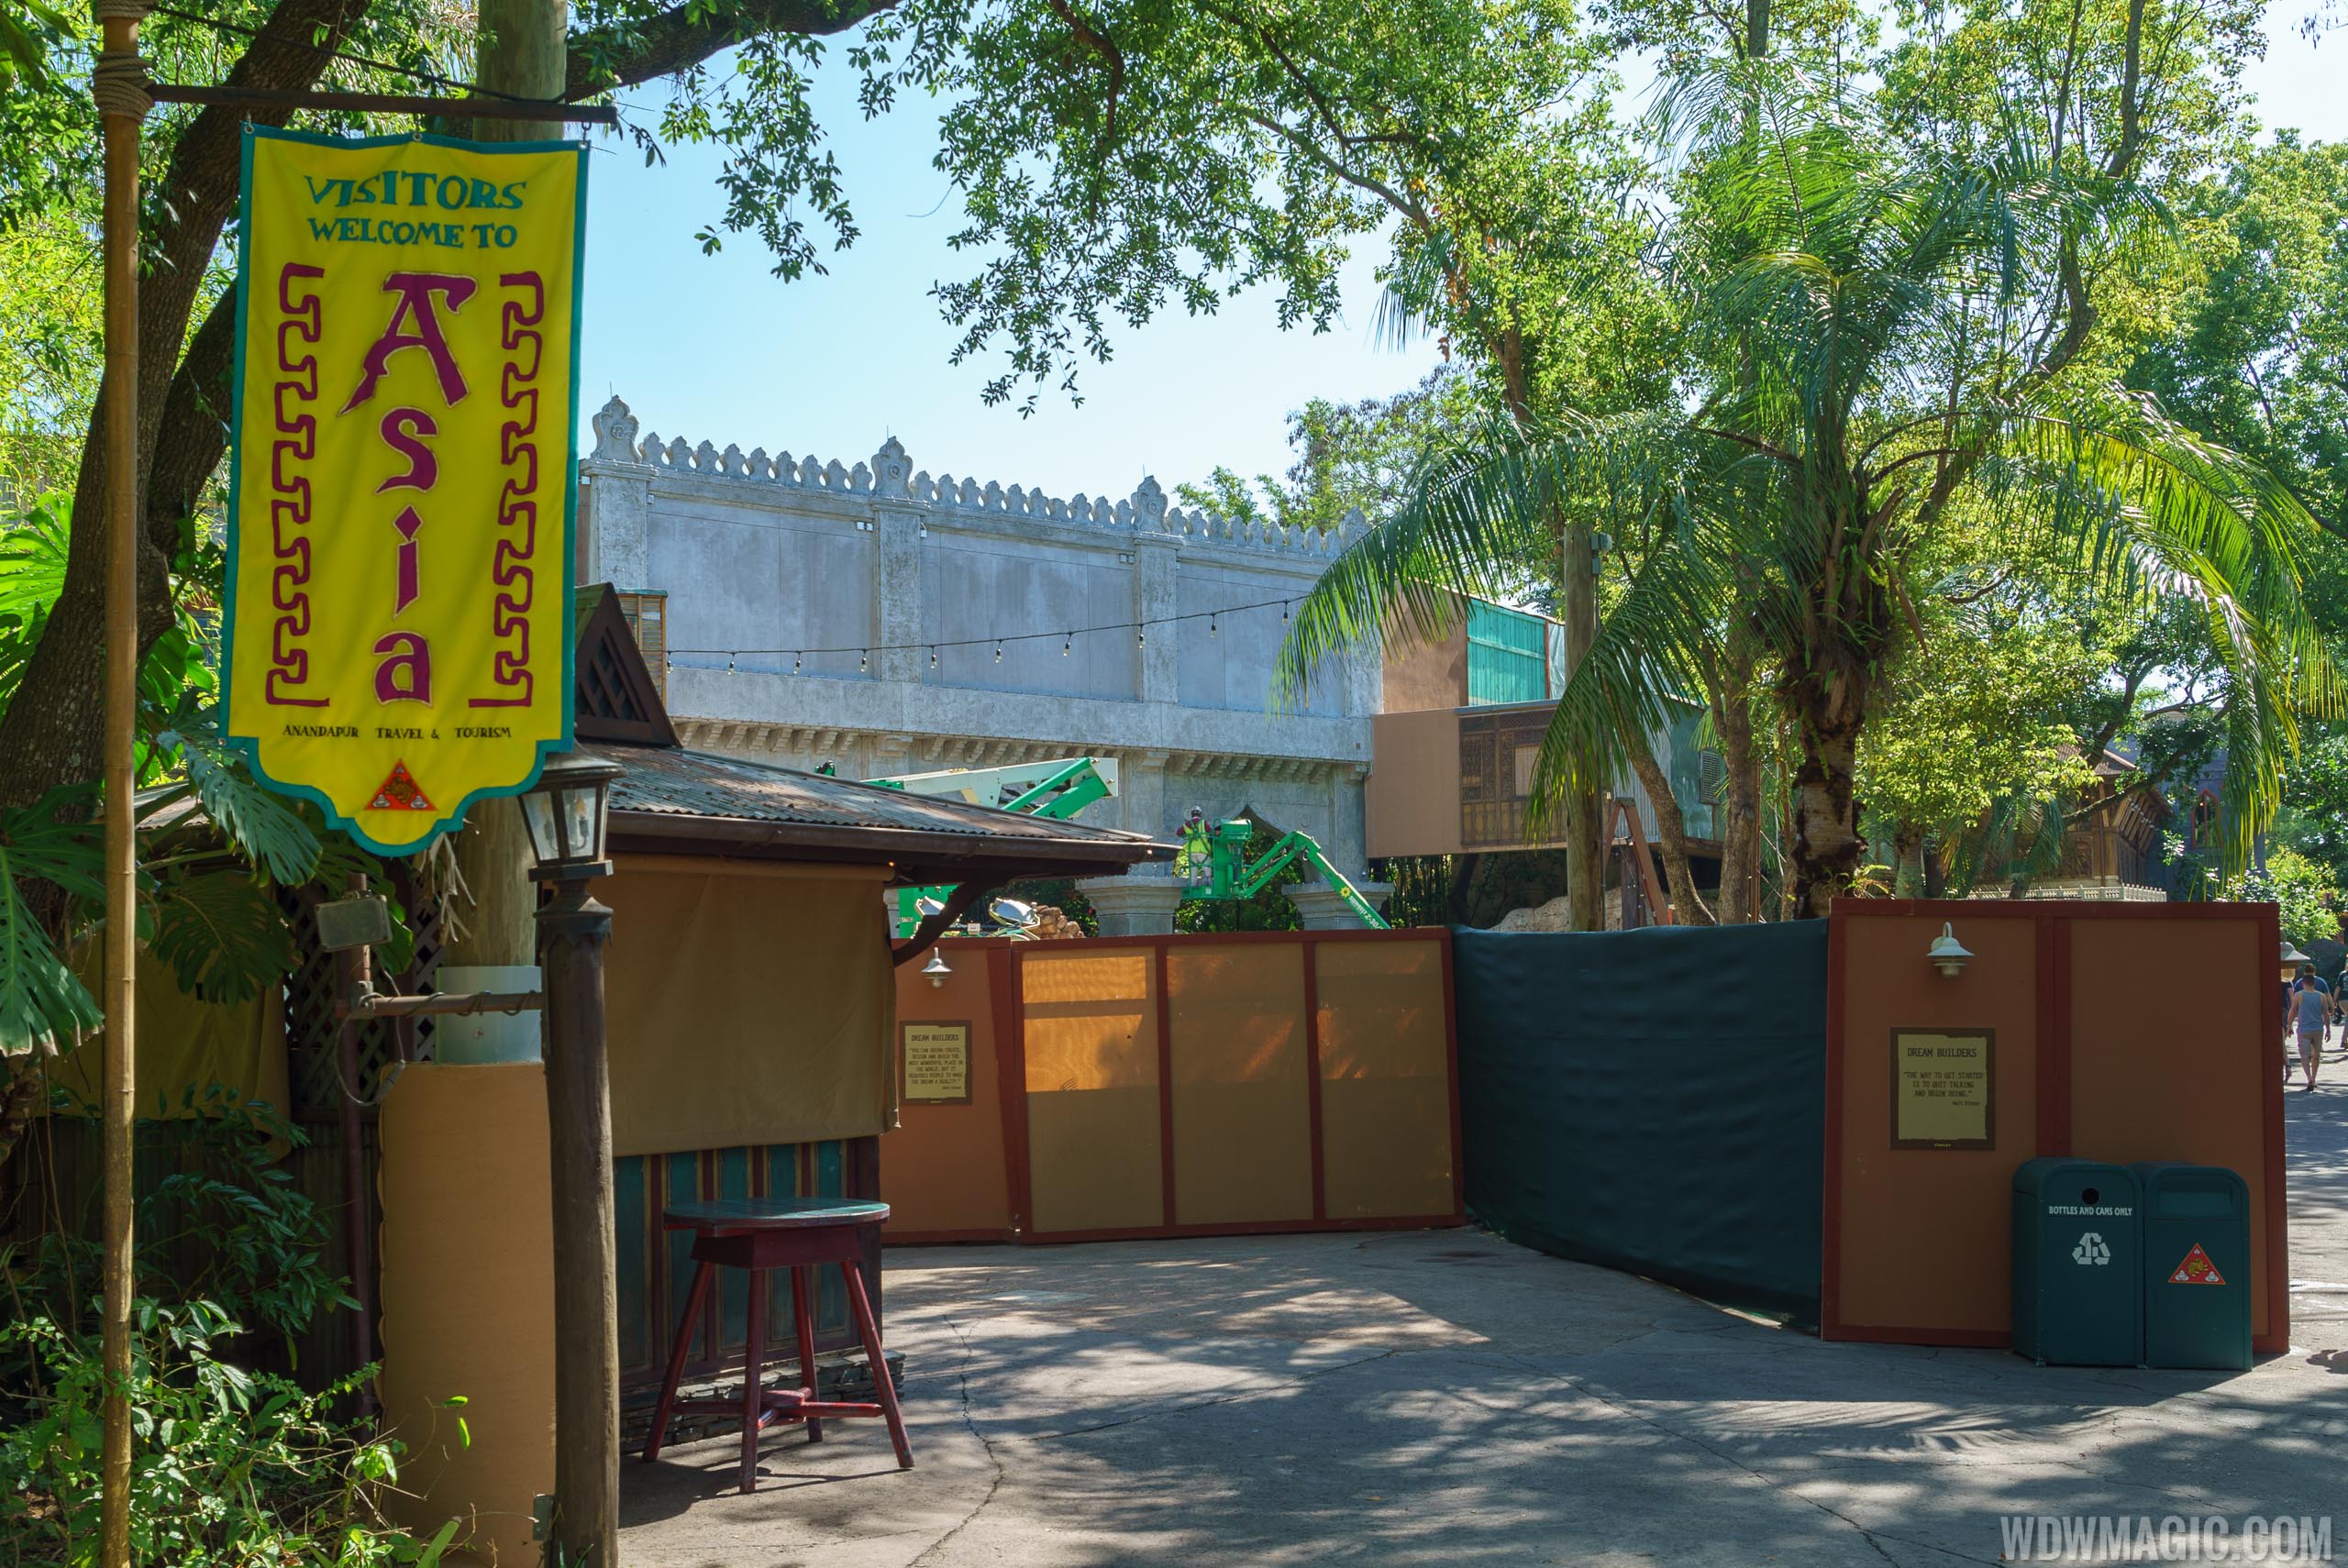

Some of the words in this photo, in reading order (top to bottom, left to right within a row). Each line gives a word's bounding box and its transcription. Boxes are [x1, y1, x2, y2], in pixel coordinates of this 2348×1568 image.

[304, 170, 527, 210] VISITORS
[307, 217, 464, 248] WELCOME
[471, 223, 518, 248] TO
[338, 271, 478, 707] Asia
[282, 724, 359, 738] ANANDAPUR
[375, 727, 425, 739] TRAVEL
[431, 730, 440, 739] &
[454, 726, 512, 738] TOURISM
[1908, 1047, 1933, 1057] DREAM
[1937, 1048, 1977, 1057] BUILDERS
[2049, 1206, 2078, 1215] BOTTLES
[2079, 1207, 2094, 1215] AND
[2096, 1207, 2113, 1216] CANS
[2114, 1208, 2132, 1216] ONLY
